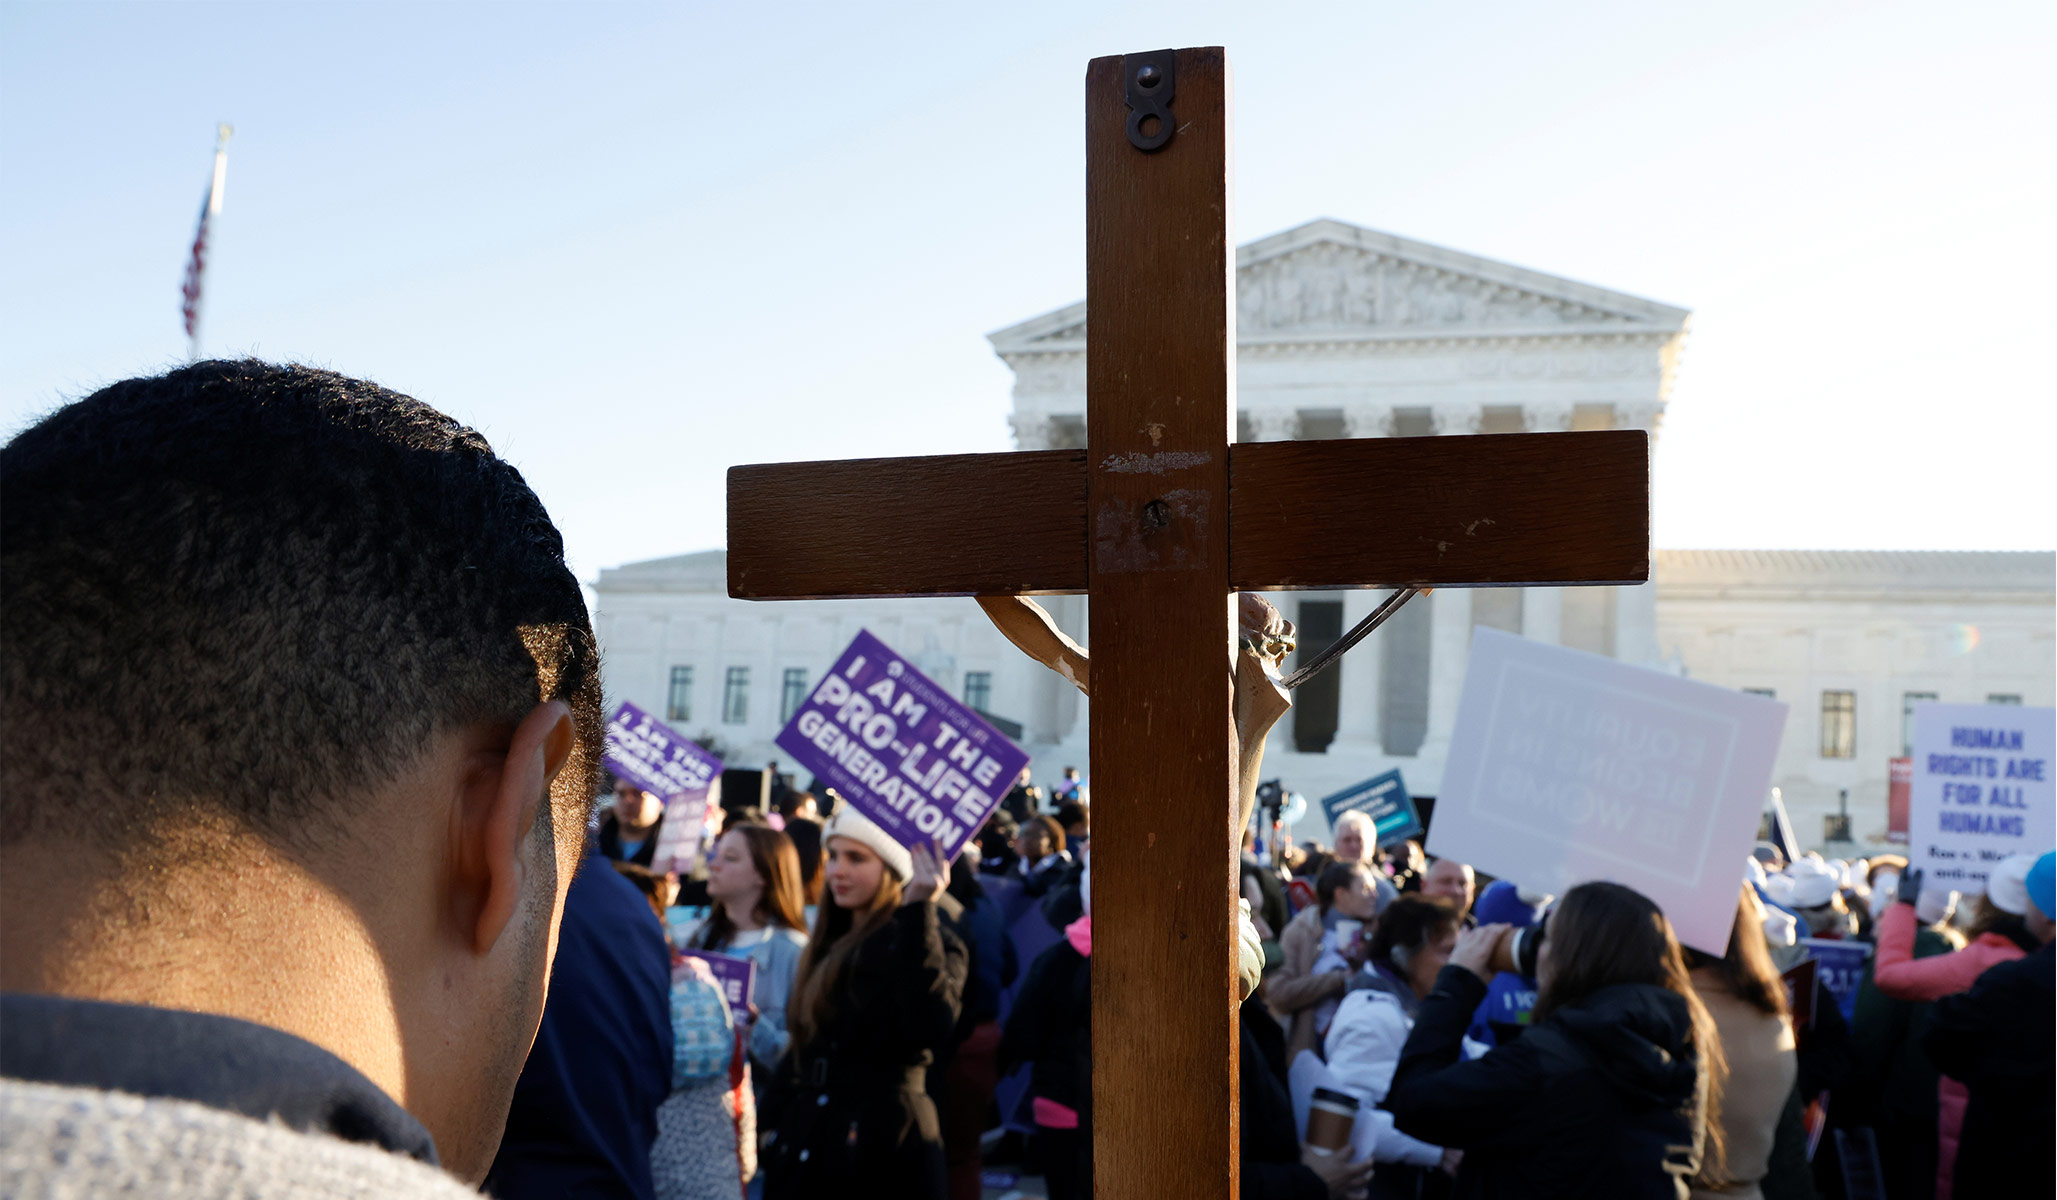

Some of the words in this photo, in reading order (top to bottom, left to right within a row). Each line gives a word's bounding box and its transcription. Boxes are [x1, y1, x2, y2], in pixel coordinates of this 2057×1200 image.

[845, 654, 867, 680] I
[866, 677, 929, 729] AM
[932, 720, 1003, 788] THE
[1951, 726, 2024, 751] HUMAN
[632, 723, 670, 751] AM
[672, 745, 714, 780] THE
[812, 673, 994, 828] PRO-LIFE
[1927, 753, 1998, 779] RIGHTS
[2004, 757, 2047, 782] ARE
[797, 708, 965, 851] GENERATION
[1941, 781, 1983, 806] FOR
[1988, 784, 2029, 810] ALL
[1939, 810, 2025, 838] HUMANS
